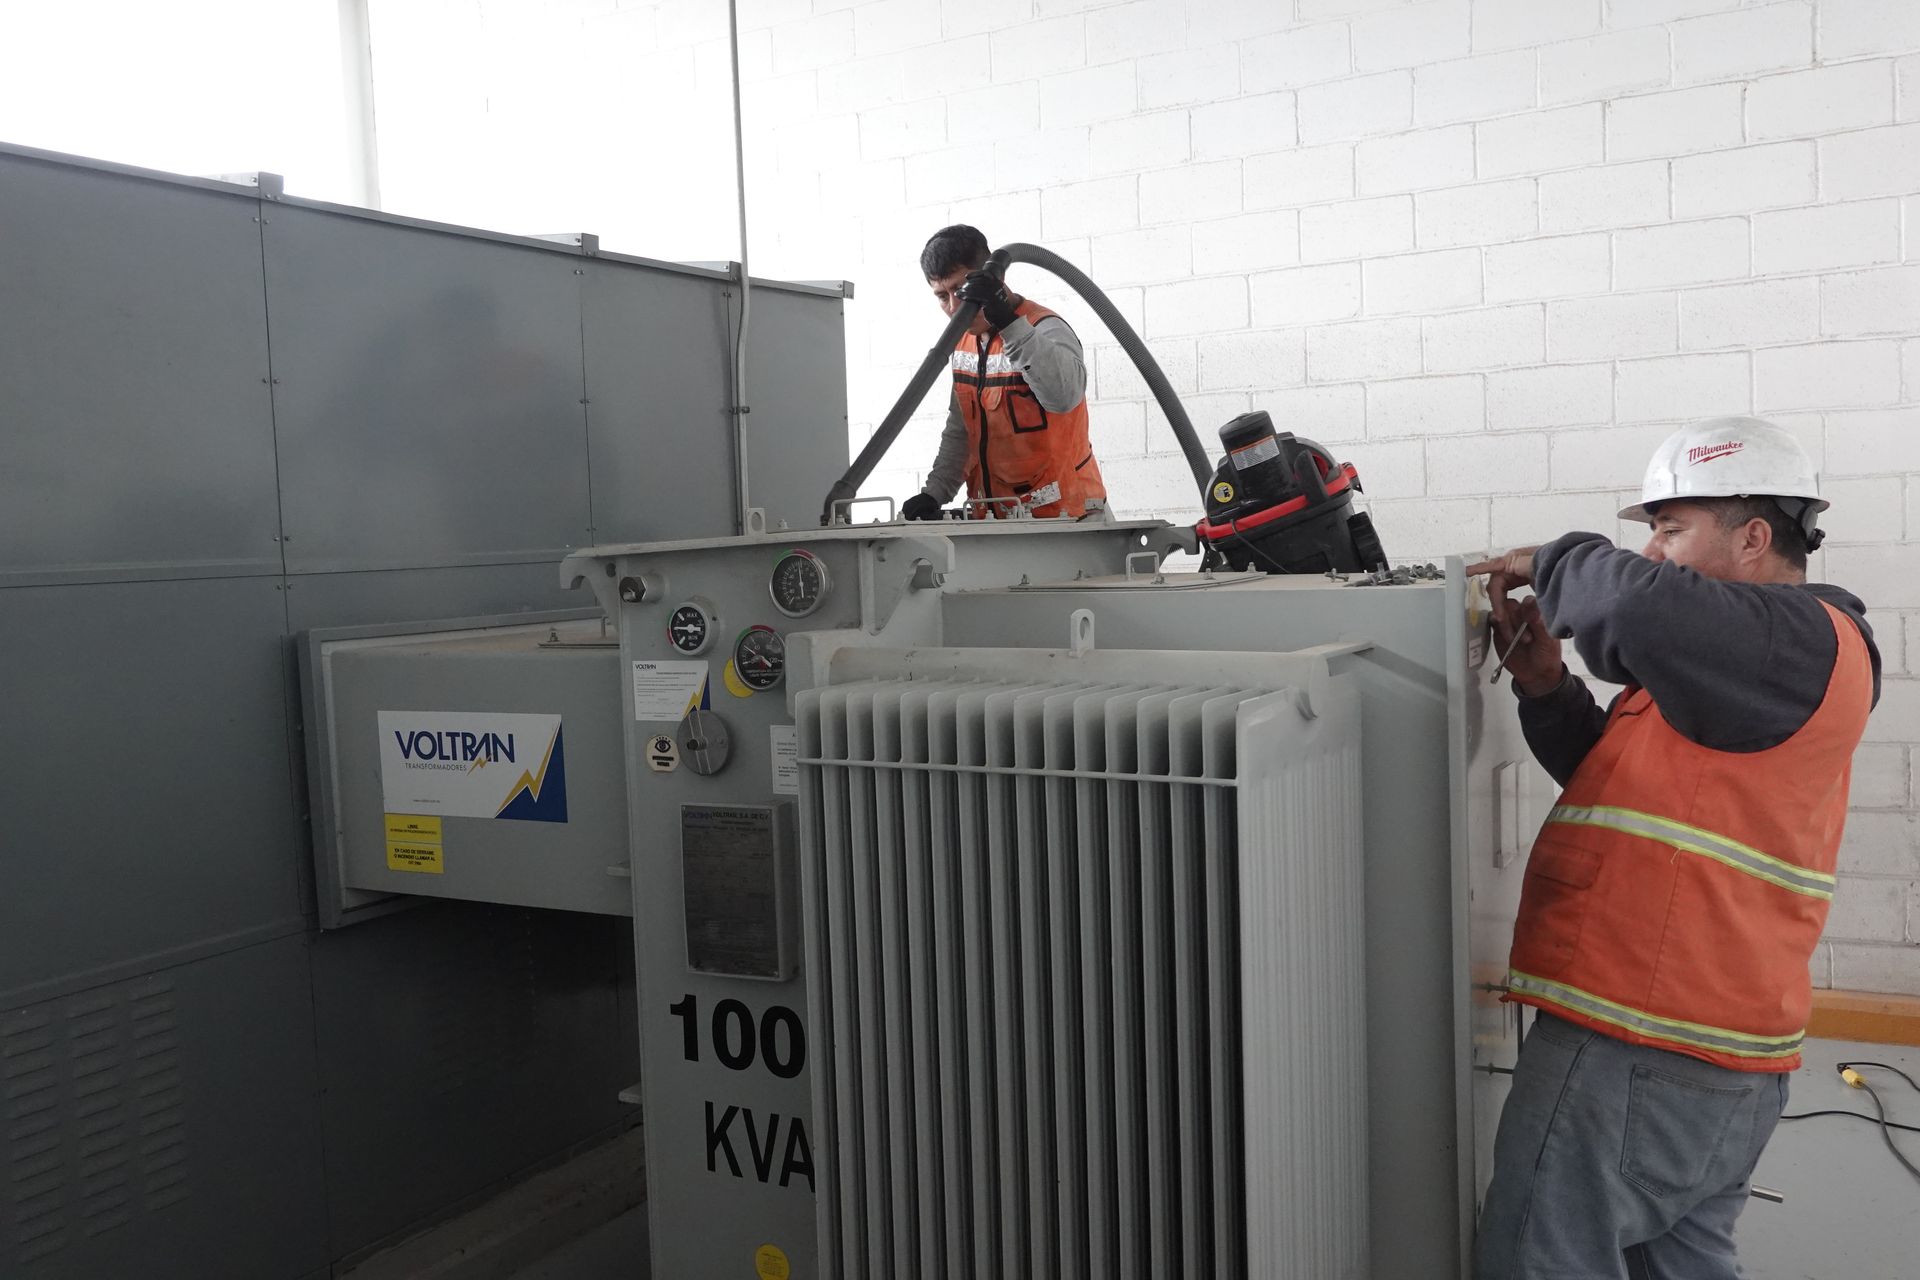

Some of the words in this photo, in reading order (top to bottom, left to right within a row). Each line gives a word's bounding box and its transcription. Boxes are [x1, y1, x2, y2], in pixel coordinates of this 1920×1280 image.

[1687, 441, 1744, 462] Milwaukee
[395, 730, 515, 763] VOLTRAN
[405, 762, 467, 772] TRANSFORMADORES
[670, 994, 806, 1078] 100
[705, 1100, 816, 1193] KVA
